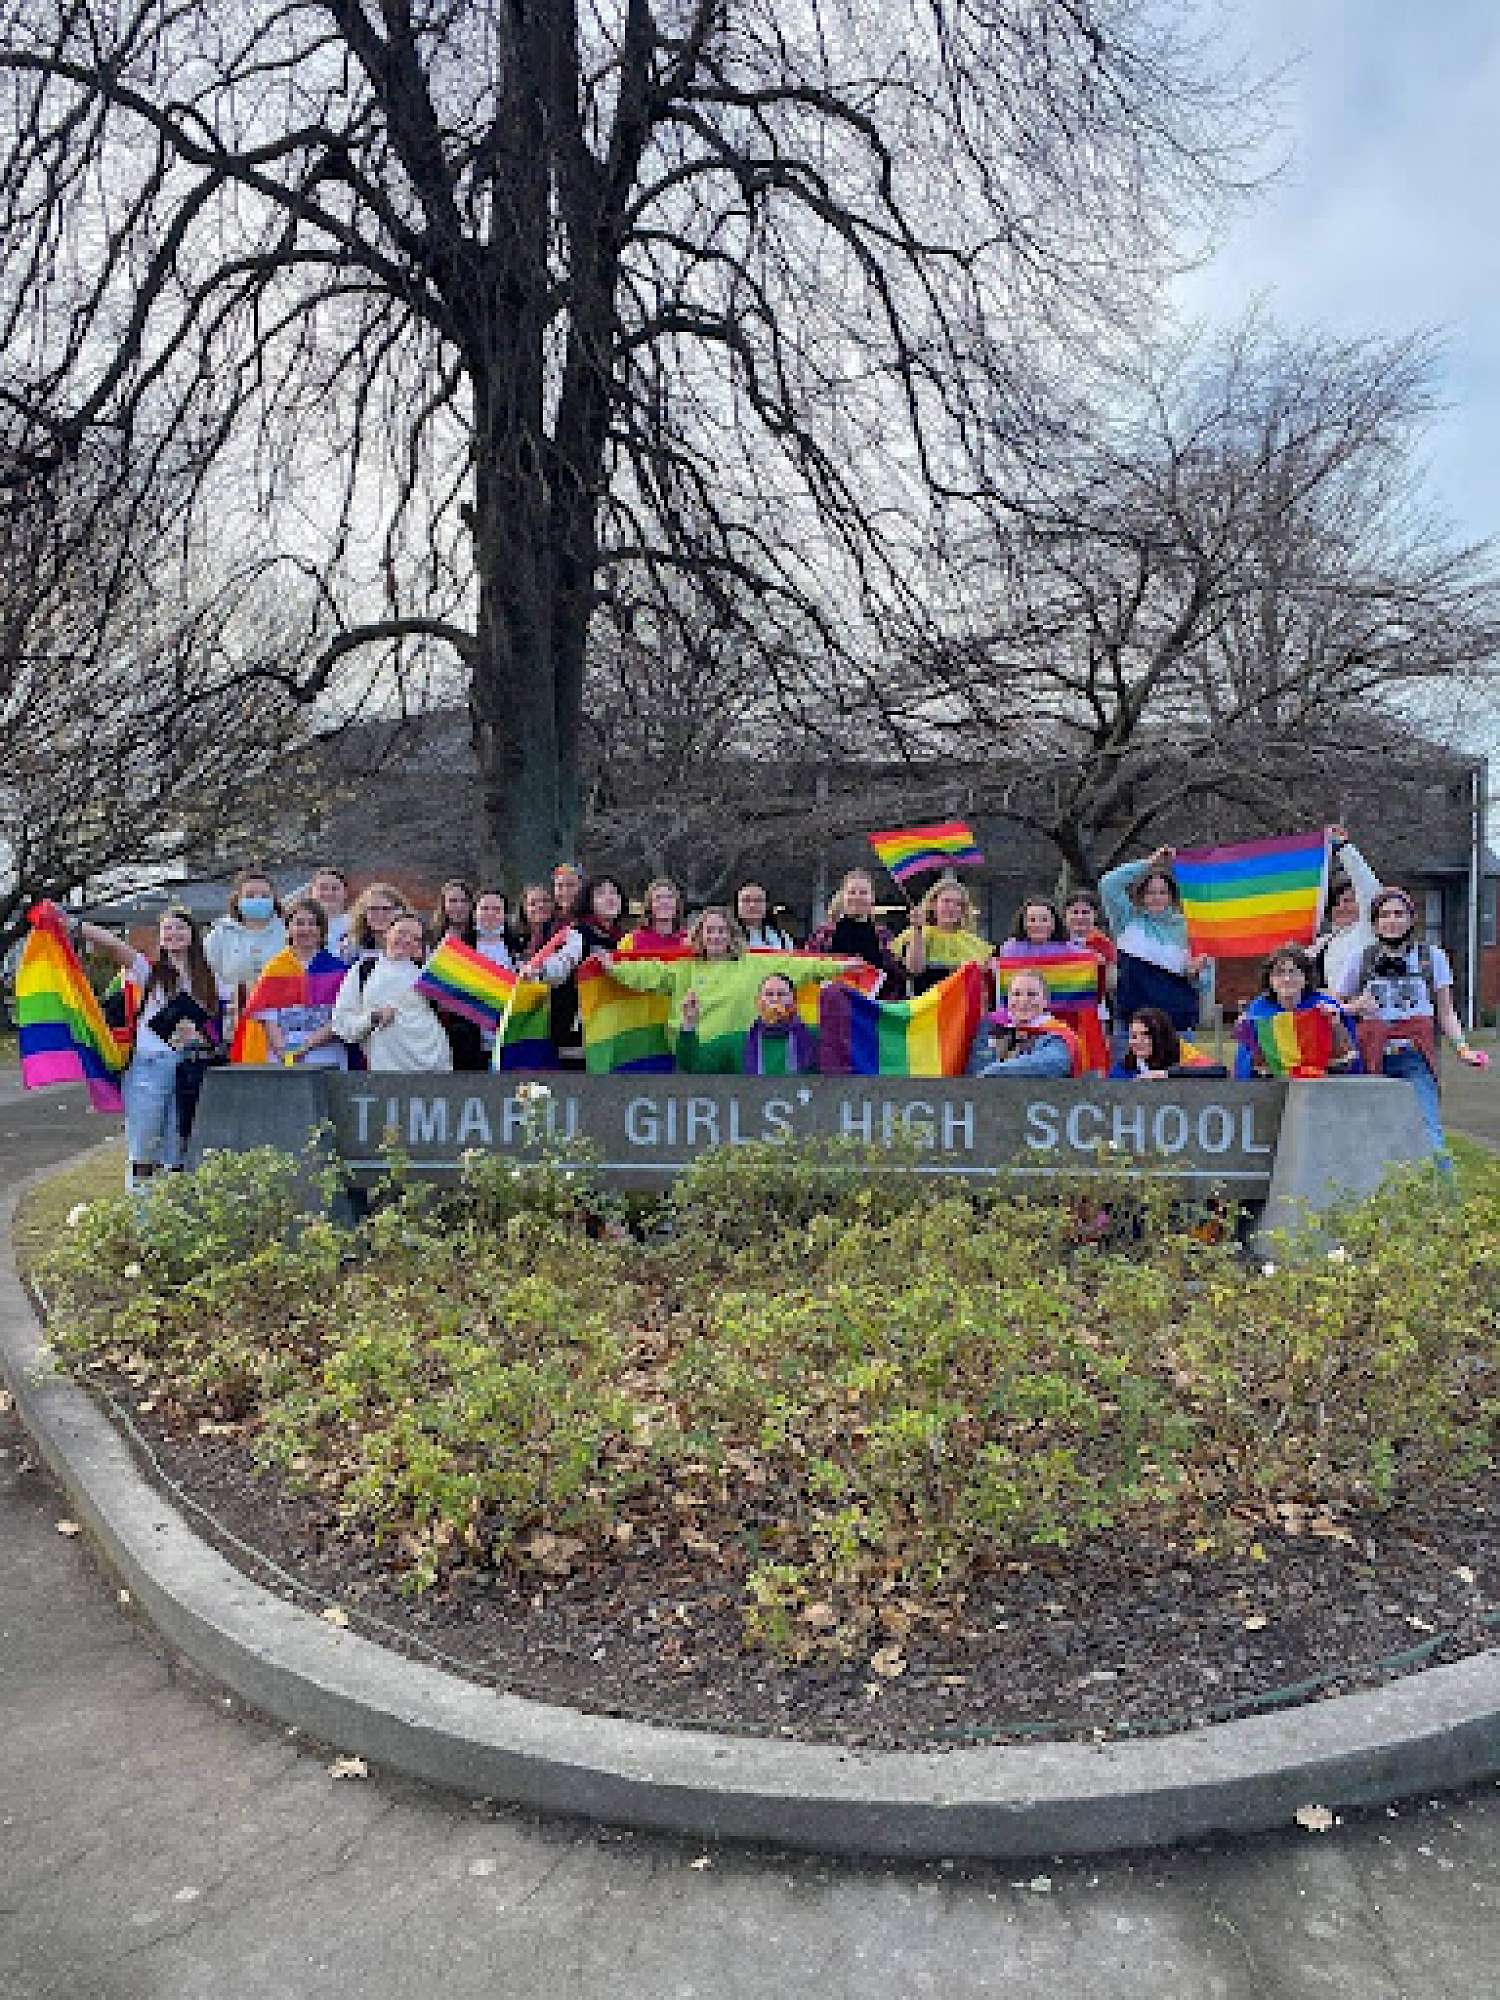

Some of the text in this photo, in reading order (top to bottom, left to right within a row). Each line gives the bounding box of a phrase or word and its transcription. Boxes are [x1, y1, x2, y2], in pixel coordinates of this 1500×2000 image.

[625, 1089, 812, 1145] GIRLS'
[840, 1100, 974, 1149] HIGH
[1024, 1101, 1270, 1153] SCHOOL
